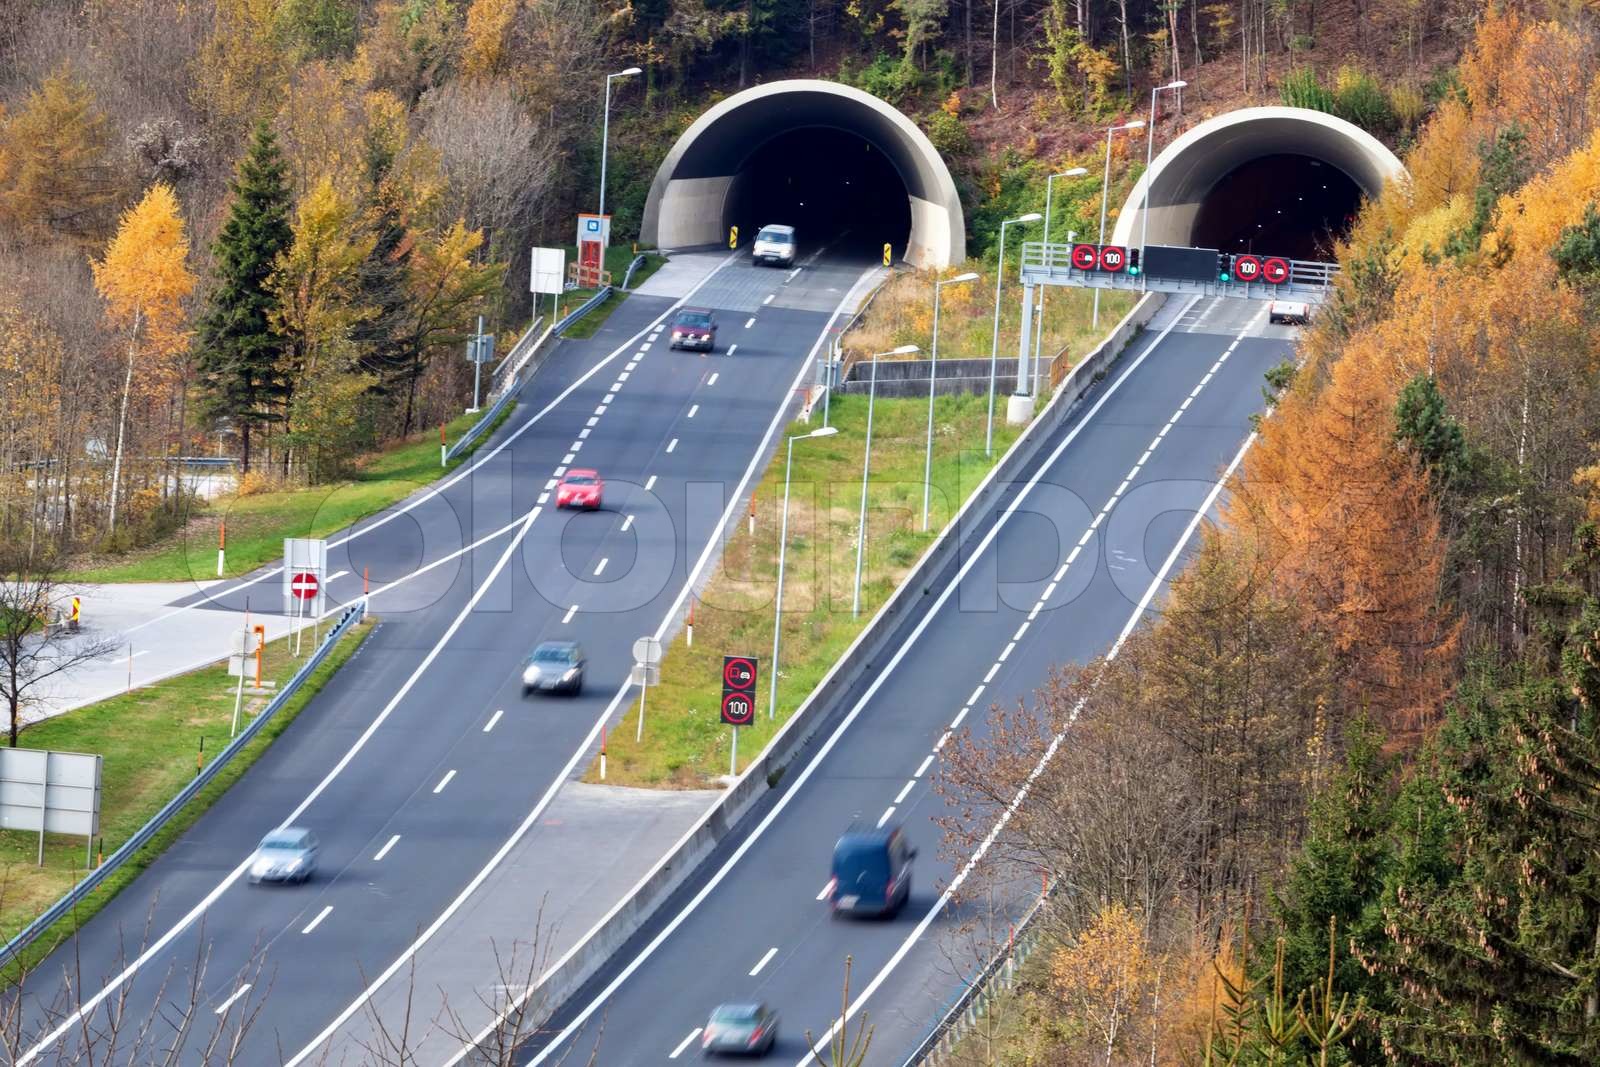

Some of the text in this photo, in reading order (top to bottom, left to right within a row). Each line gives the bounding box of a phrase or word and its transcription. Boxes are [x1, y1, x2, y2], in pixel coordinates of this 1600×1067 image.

[1104, 253, 1121, 264] 100
[1240, 262, 1256, 274] 100
[728, 701, 748, 715] 100
